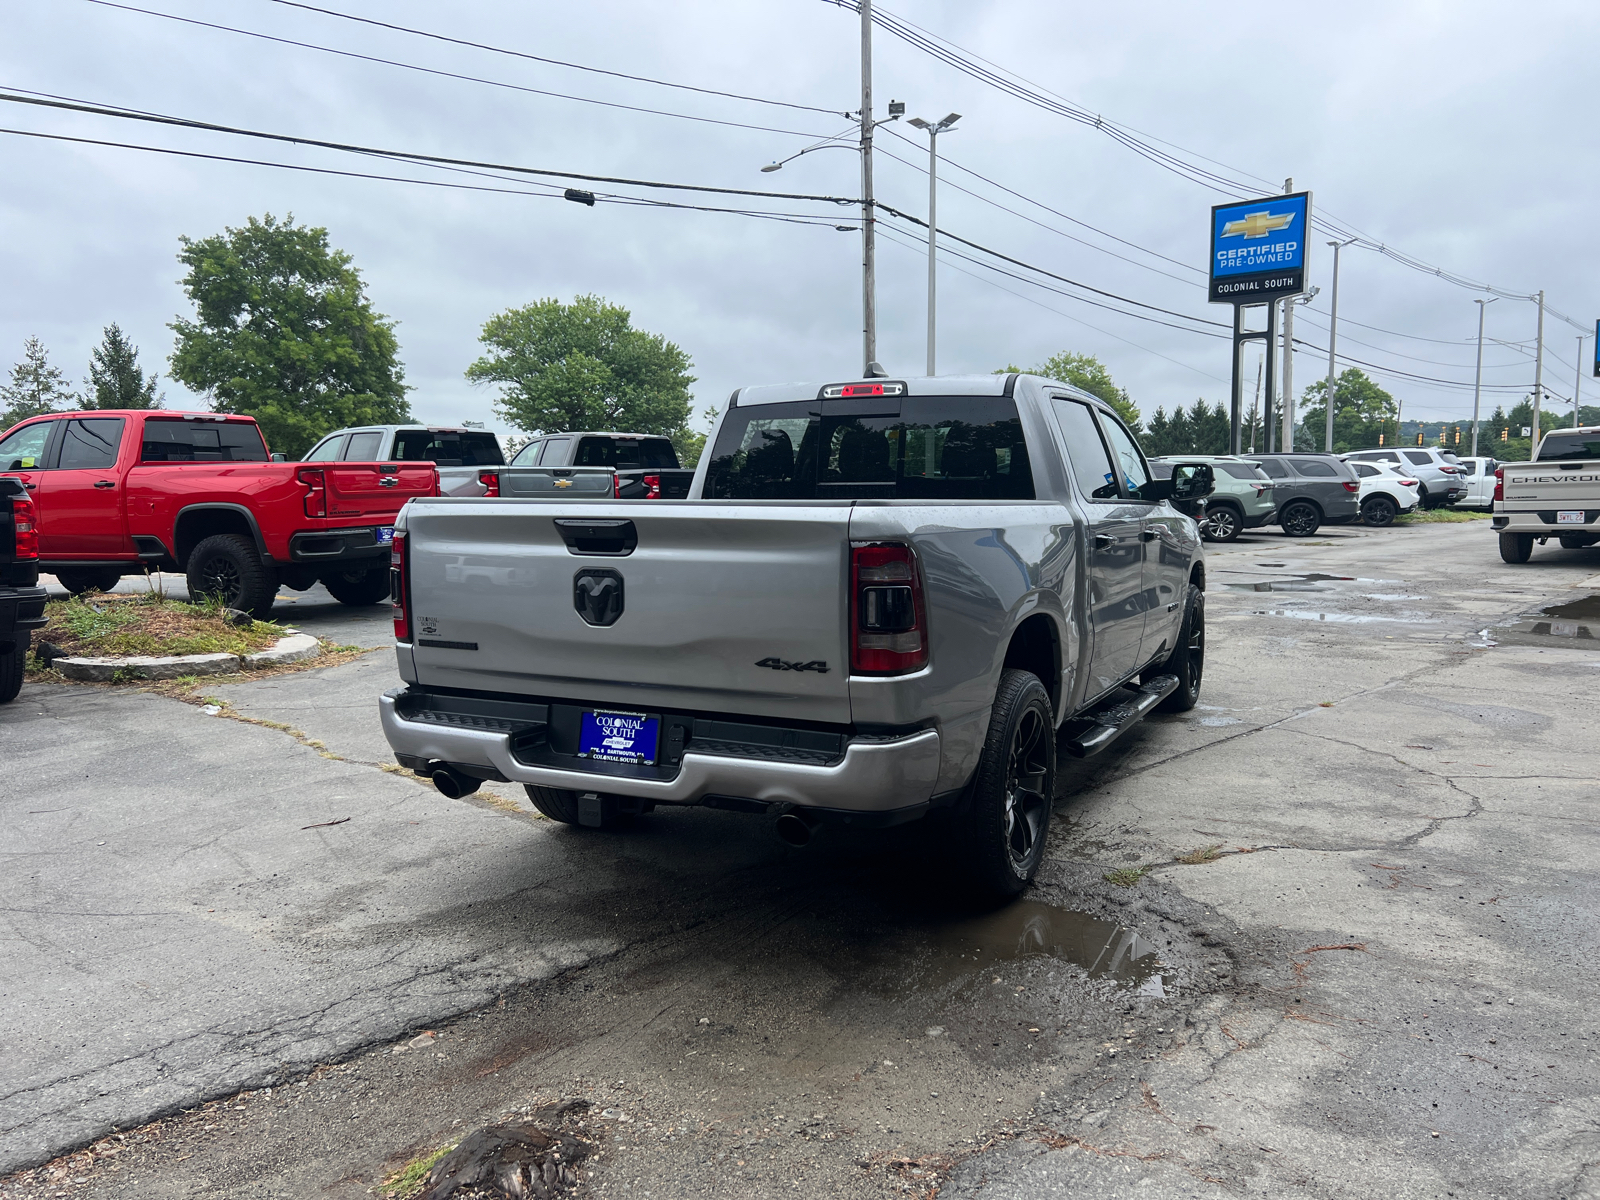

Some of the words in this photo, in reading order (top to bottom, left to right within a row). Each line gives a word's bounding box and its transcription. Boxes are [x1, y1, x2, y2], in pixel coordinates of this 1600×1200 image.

[1217, 241, 1297, 260] CERTIFIED
[1220, 251, 1292, 268] PRE-OWNED
[1218, 281, 1260, 294] COLONIAL
[1264, 277, 1294, 289] SOUTH
[754, 656, 831, 674] 4x4
[596, 716, 643, 730] COLONIAL
[602, 726, 635, 738] SOUTH
